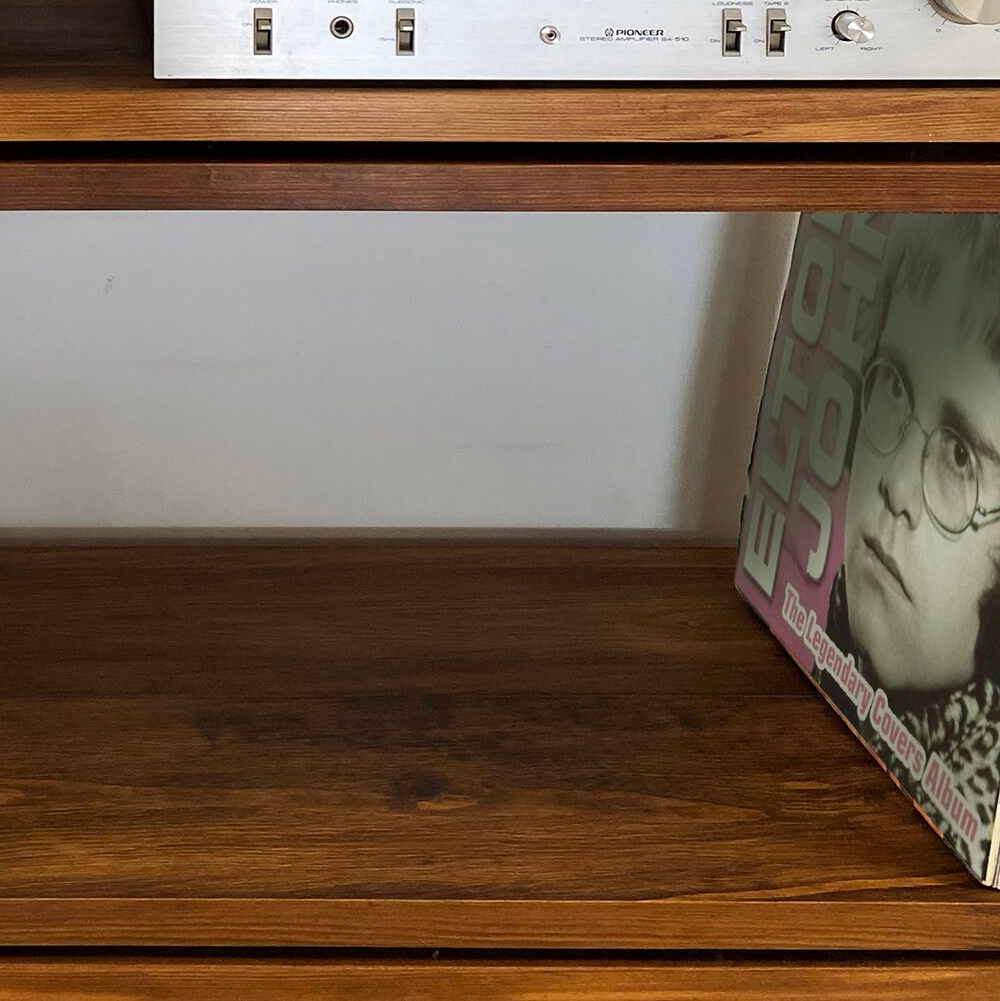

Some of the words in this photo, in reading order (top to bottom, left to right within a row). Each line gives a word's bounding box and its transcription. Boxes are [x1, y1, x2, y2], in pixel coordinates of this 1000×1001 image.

[743, 212, 845, 600] ELTO
[783, 589, 806, 635] The
[804, 615, 873, 716] Legendary
[872, 690, 926, 776] Covers
[924, 761, 980, 842] Album
